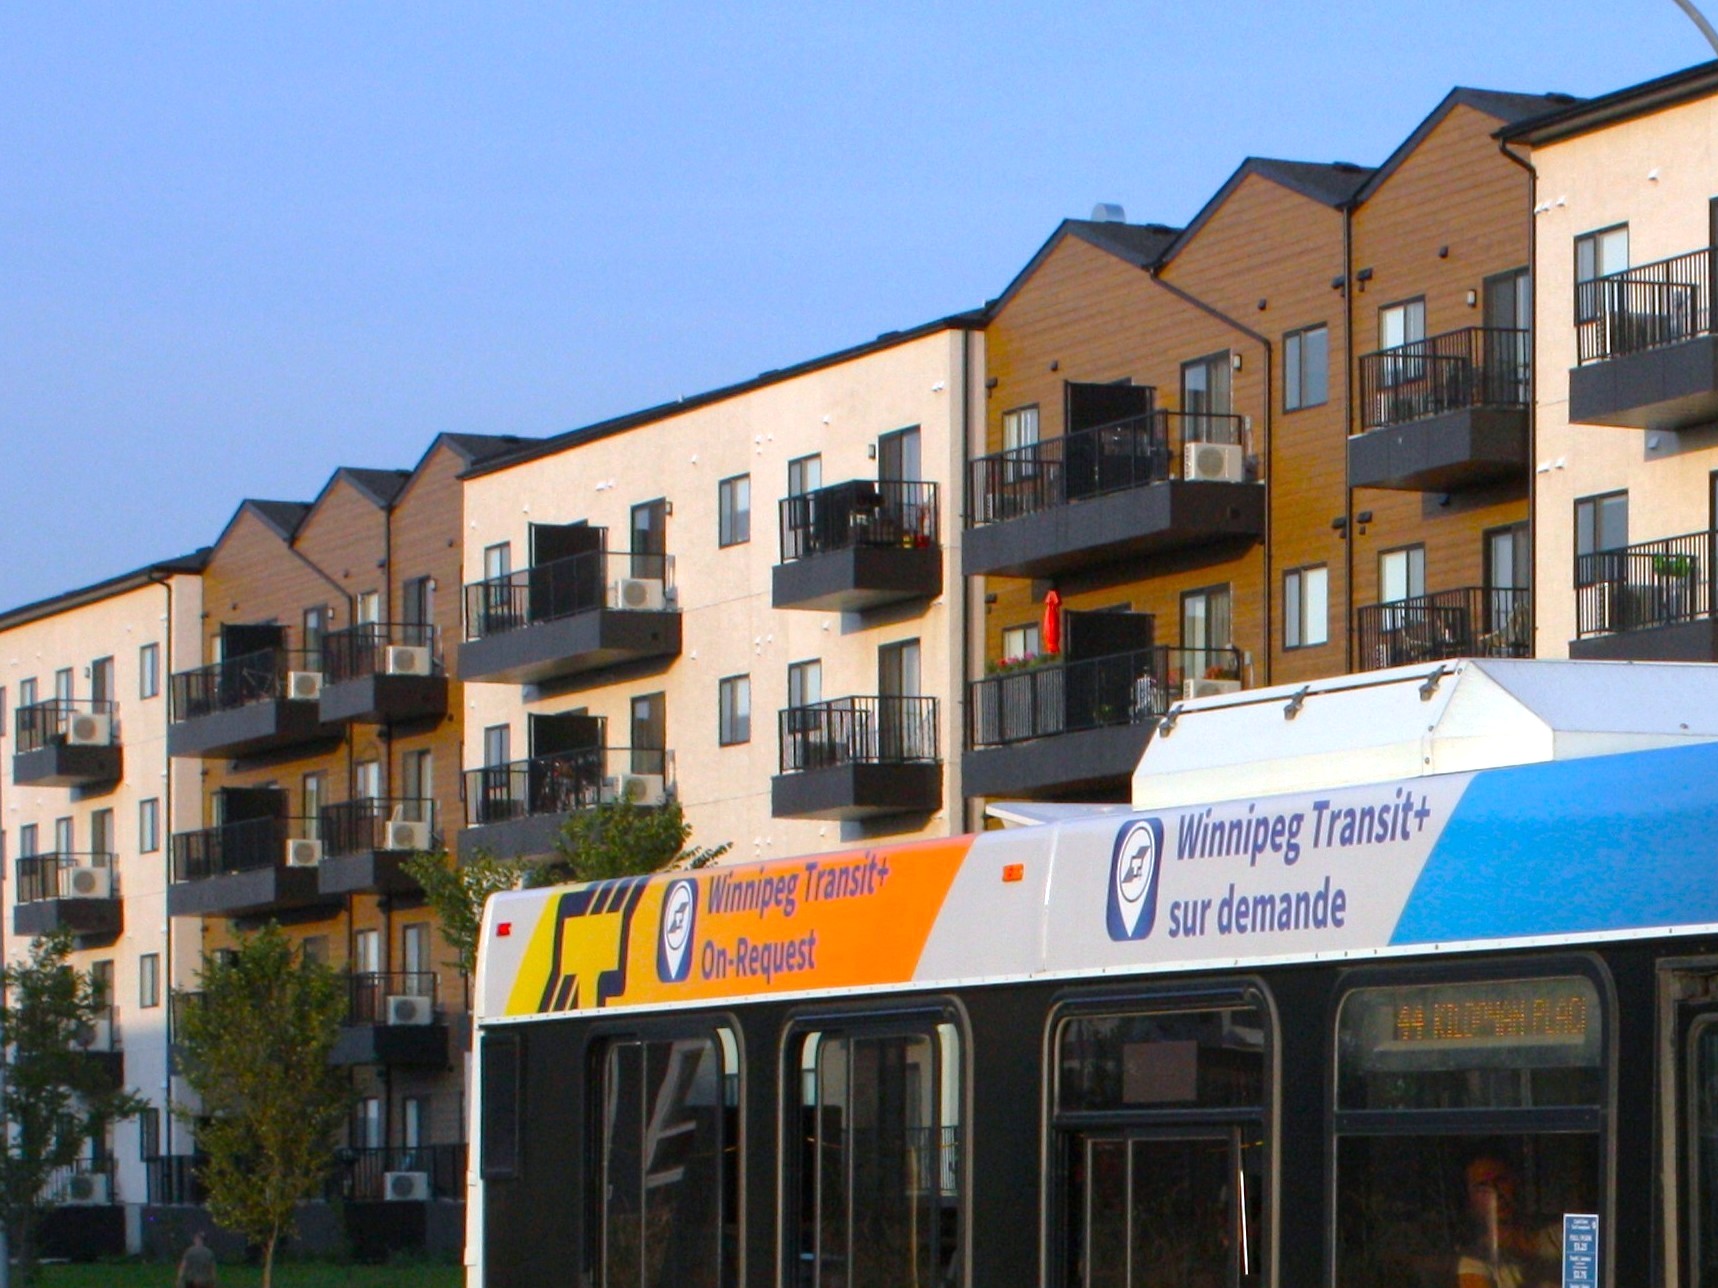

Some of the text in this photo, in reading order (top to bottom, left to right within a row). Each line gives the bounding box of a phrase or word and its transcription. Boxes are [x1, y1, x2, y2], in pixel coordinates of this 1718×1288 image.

[1176, 786, 1431, 867] Winnipeg Transit+
[707, 851, 890, 916] Winnipeg Transit+
[1168, 875, 1347, 938] sur demande
[701, 929, 817, 985] On-Request
